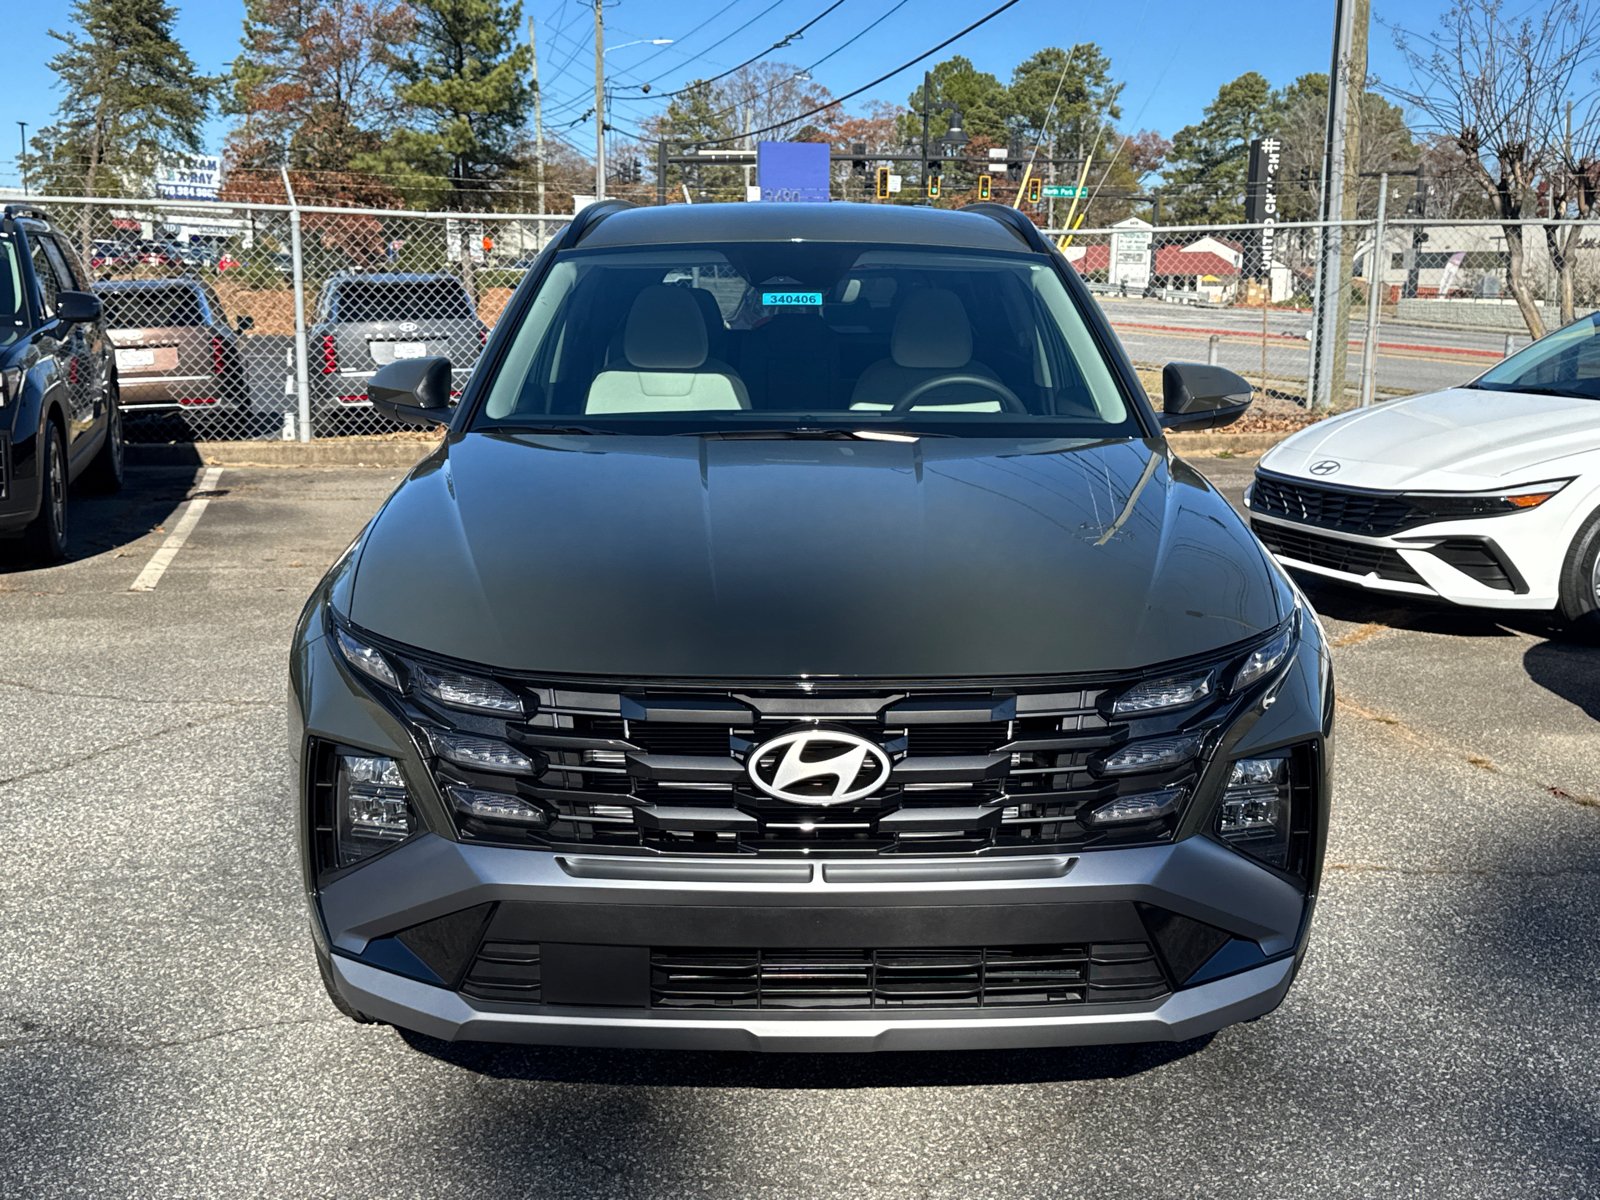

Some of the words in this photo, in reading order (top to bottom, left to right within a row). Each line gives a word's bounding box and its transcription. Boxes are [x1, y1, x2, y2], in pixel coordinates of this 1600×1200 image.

[1264, 153, 1280, 214] CHCH
[1043, 187, 1059, 195] North
[1060, 188, 1074, 196] Park
[770, 295, 816, 304] 340406
